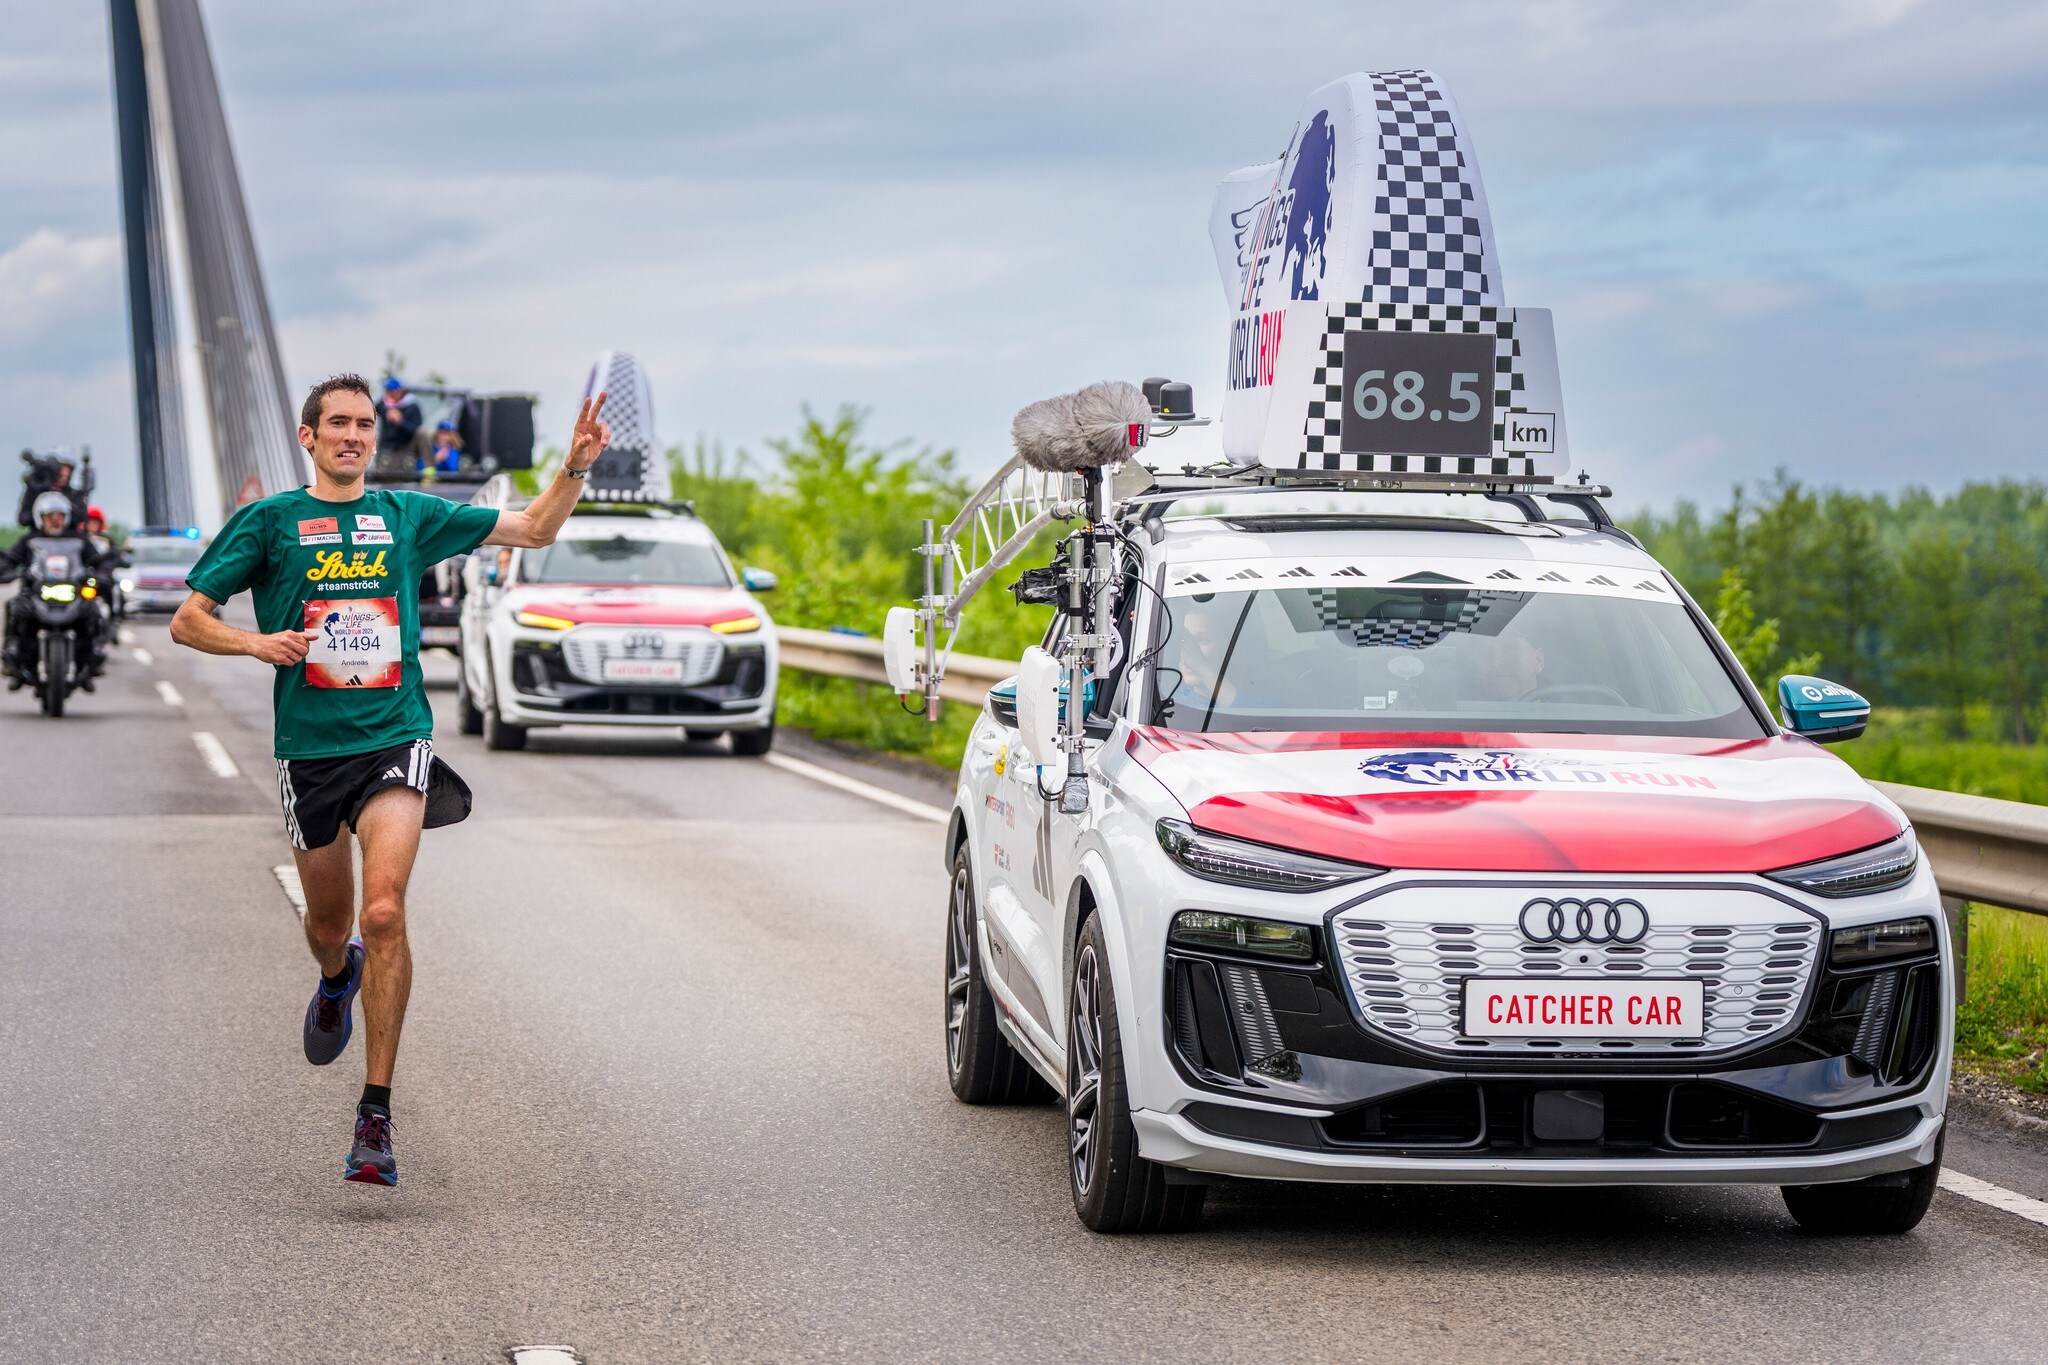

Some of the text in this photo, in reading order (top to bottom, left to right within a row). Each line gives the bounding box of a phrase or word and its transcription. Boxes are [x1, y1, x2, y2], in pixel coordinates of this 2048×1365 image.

[1352, 369, 1482, 423] 68.5
[1511, 421, 1547, 443] km
[307, 551, 388, 580] Ströck
[317, 580, 380, 591] #teamströck
[327, 635, 381, 651] 41494
[383, 668, 389, 679] 1
[1822, 685, 1857, 700] allwy
[1421, 769, 1718, 790] WORLD RUN
[1487, 994, 1682, 1025] CATCHER CAR
